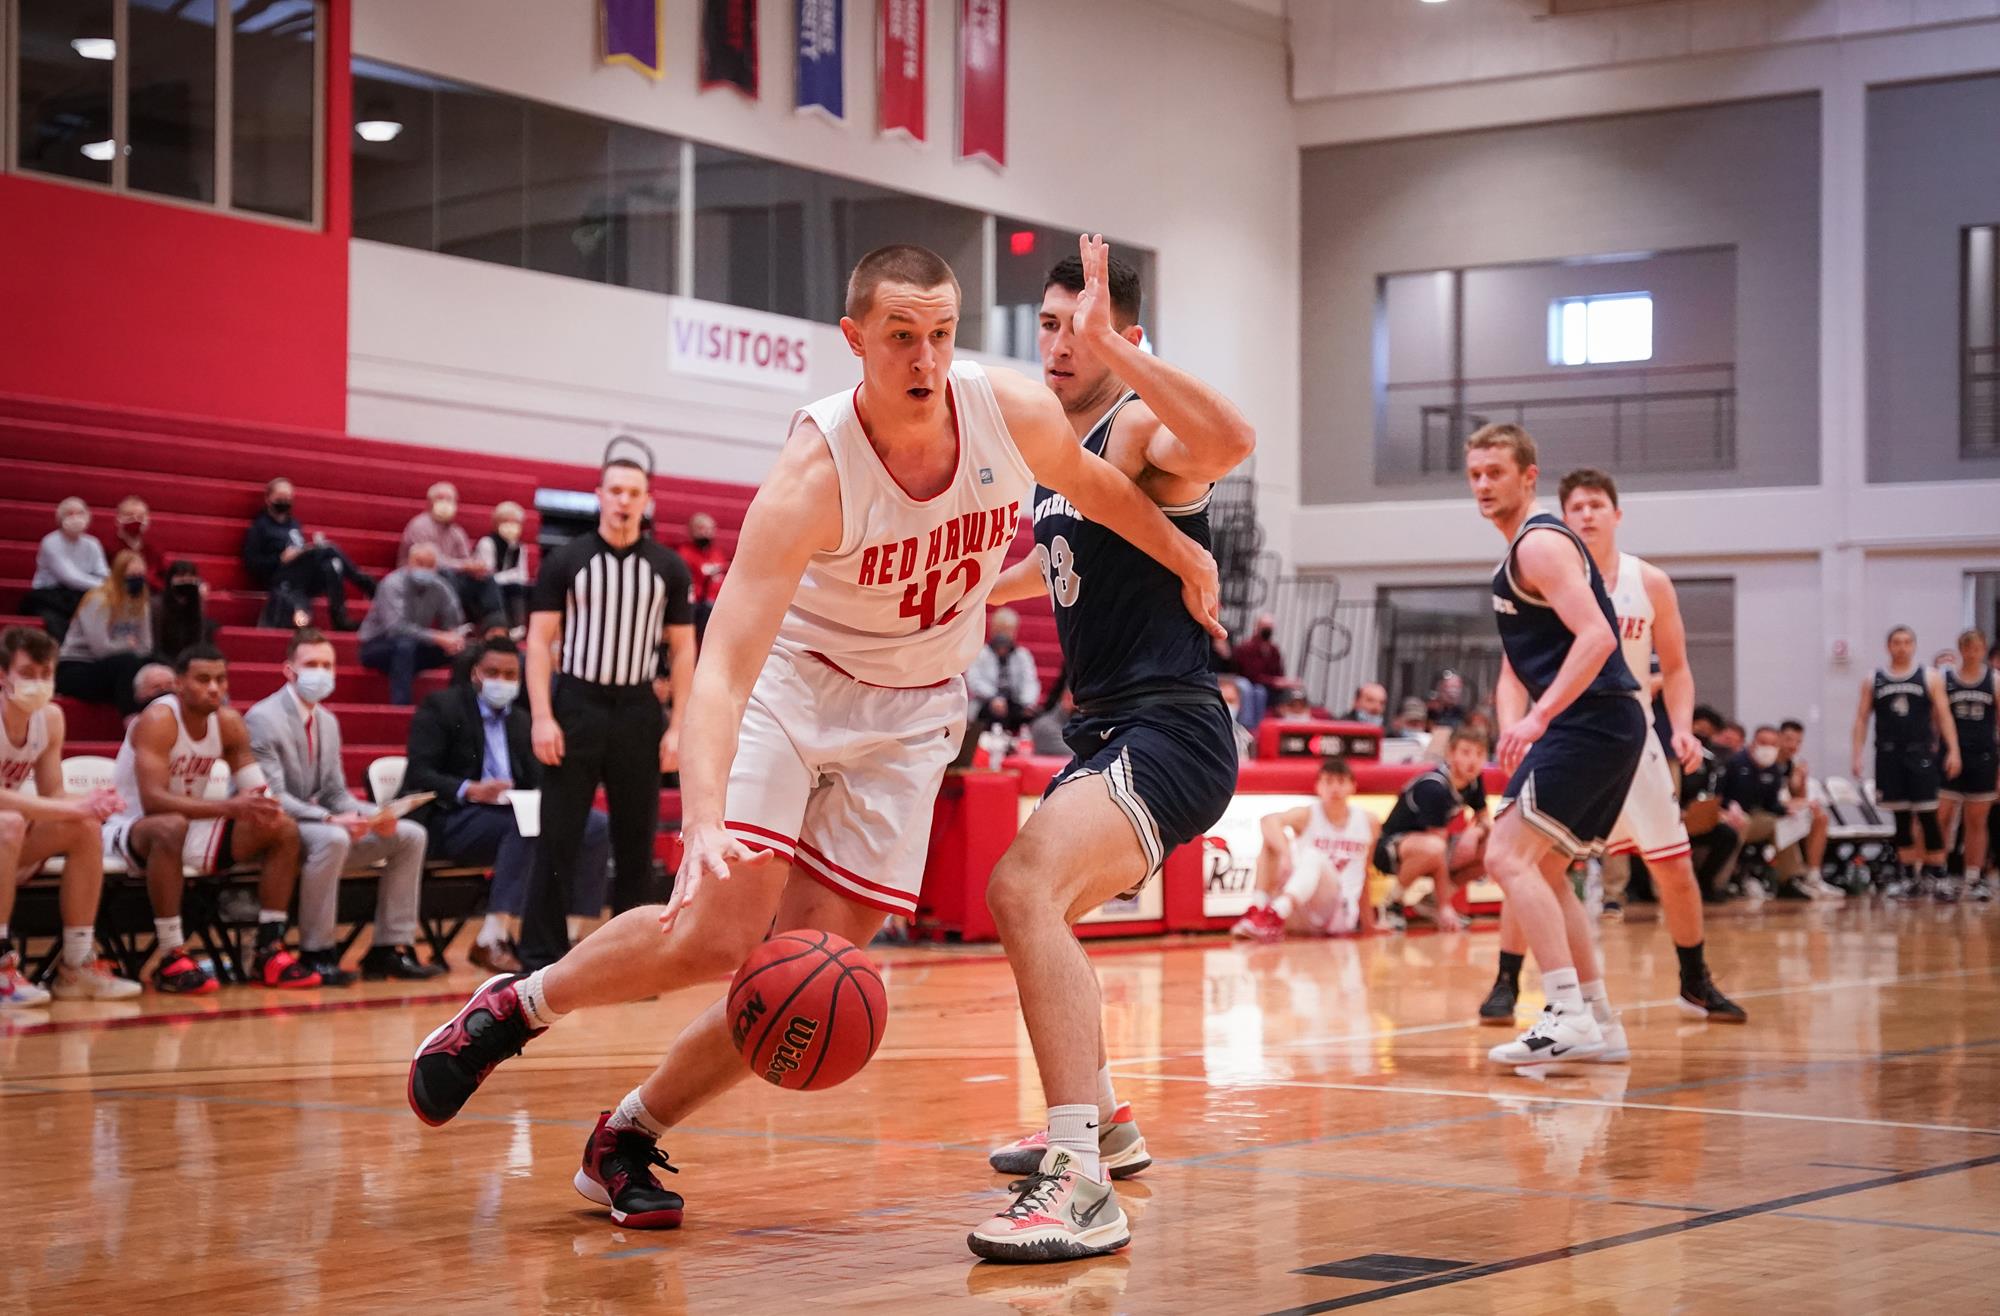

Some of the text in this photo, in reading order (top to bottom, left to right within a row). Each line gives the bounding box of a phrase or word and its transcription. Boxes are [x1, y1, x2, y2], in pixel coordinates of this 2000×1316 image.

[673, 317, 806, 374] VISITORS
[858, 501, 1019, 586] RED HAWKS
[899, 558, 981, 630] 42
[763, 1014, 821, 1087] Wilso
